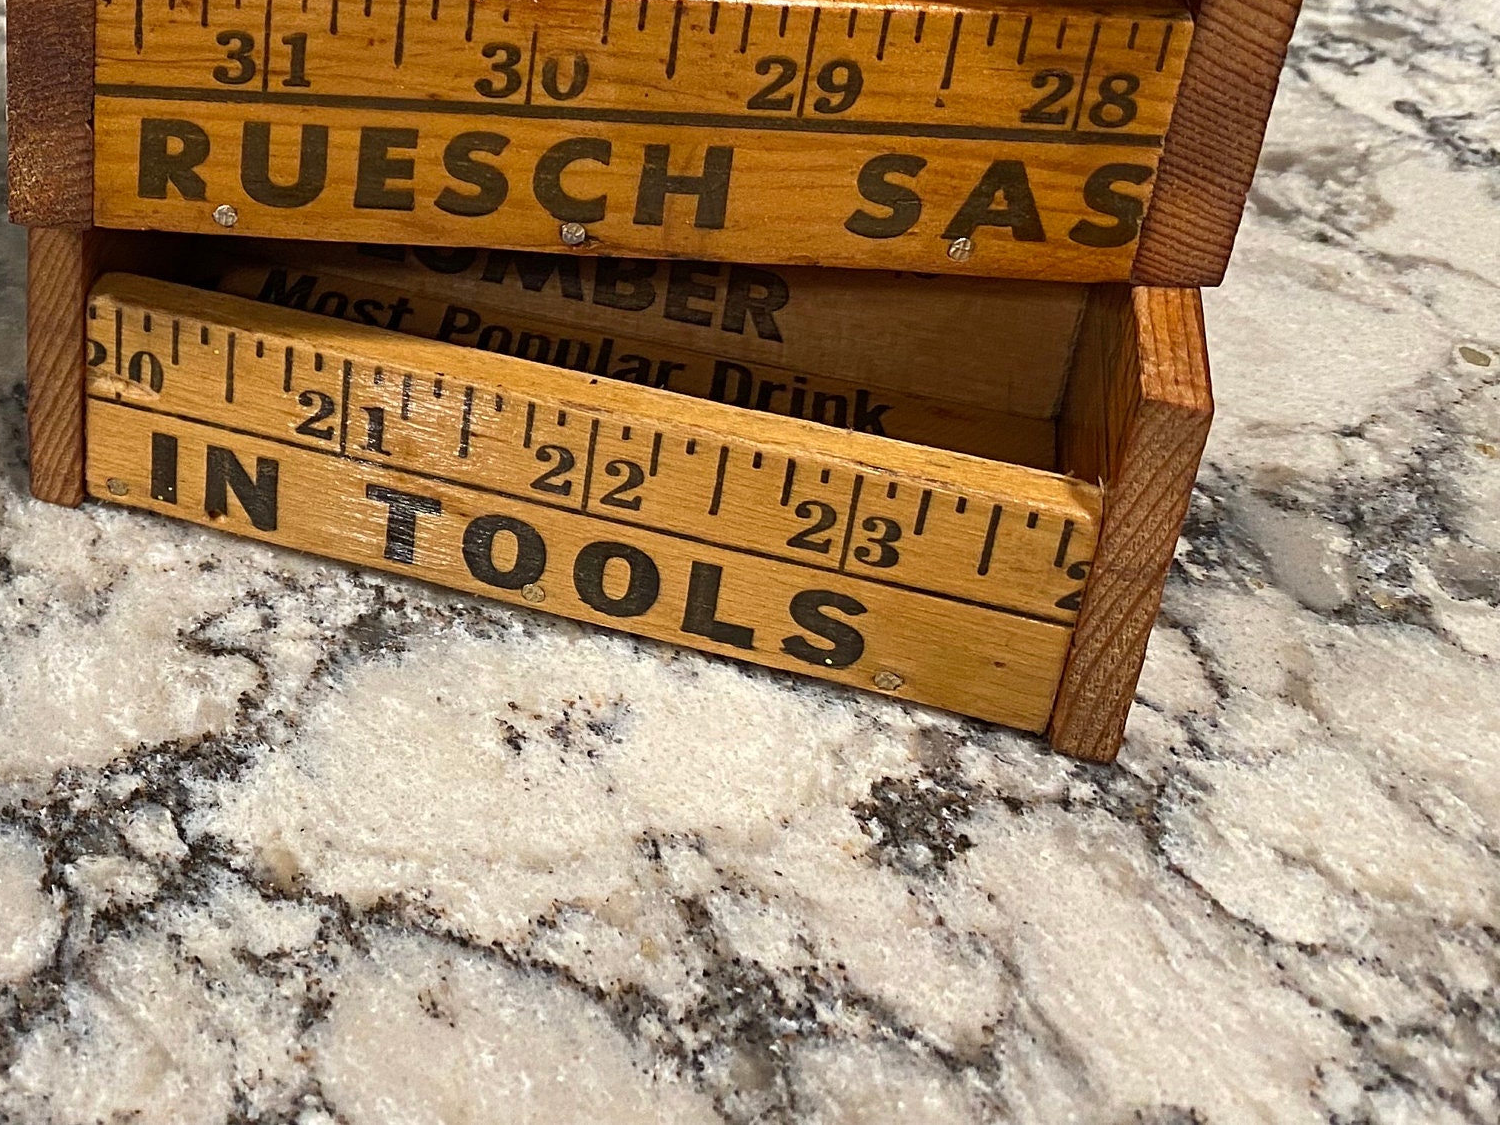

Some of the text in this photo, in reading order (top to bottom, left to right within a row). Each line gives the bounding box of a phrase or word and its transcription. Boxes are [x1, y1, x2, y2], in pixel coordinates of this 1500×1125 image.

[212, 30, 1139, 129] 31 30 29 28
[137, 117, 1155, 248] RUESCH SAS
[255, 267, 414, 331] Most
[708, 360, 893, 435] Drink
[150, 432, 868, 669] IN TOOLS
[295, 389, 393, 457] 21
[529, 444, 643, 513] 22
[786, 500, 903, 569] 23
